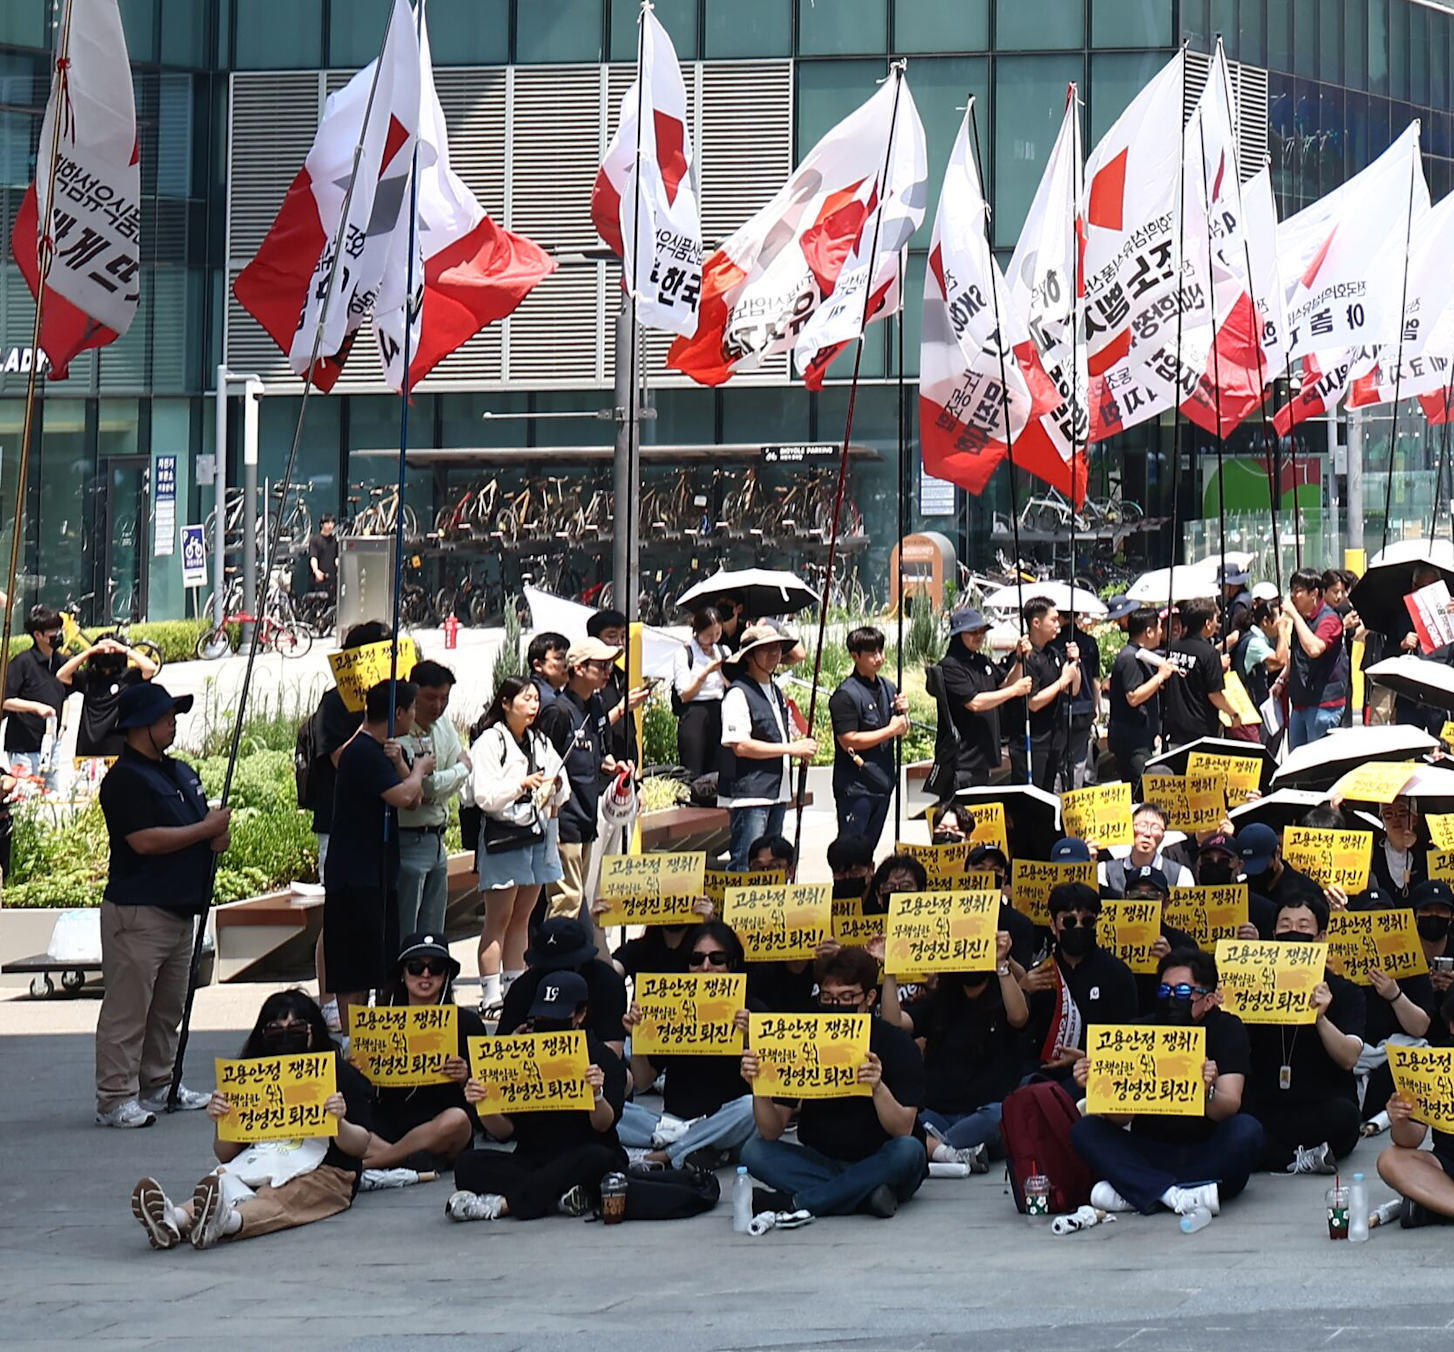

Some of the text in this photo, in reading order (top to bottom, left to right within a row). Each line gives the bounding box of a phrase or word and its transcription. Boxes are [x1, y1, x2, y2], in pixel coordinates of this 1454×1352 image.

[0, 347, 47, 373] ADY
[477, 1036, 578, 1061] 고용안정 쟁취!
[1095, 1029, 1198, 1052] 고용안정 쟁취!
[218, 1057, 327, 1086] 고용안정 쟁취!
[479, 1067, 518, 1082] 무책임한
[1094, 1060, 1134, 1076] 무책임한
[218, 1092, 260, 1109] 무책임한
[499, 1079, 585, 1103] 경영진 퇴진!
[1112, 1077, 1198, 1101] 경영진 퇴진!
[238, 1104, 329, 1131] 경영진 퇴진!
